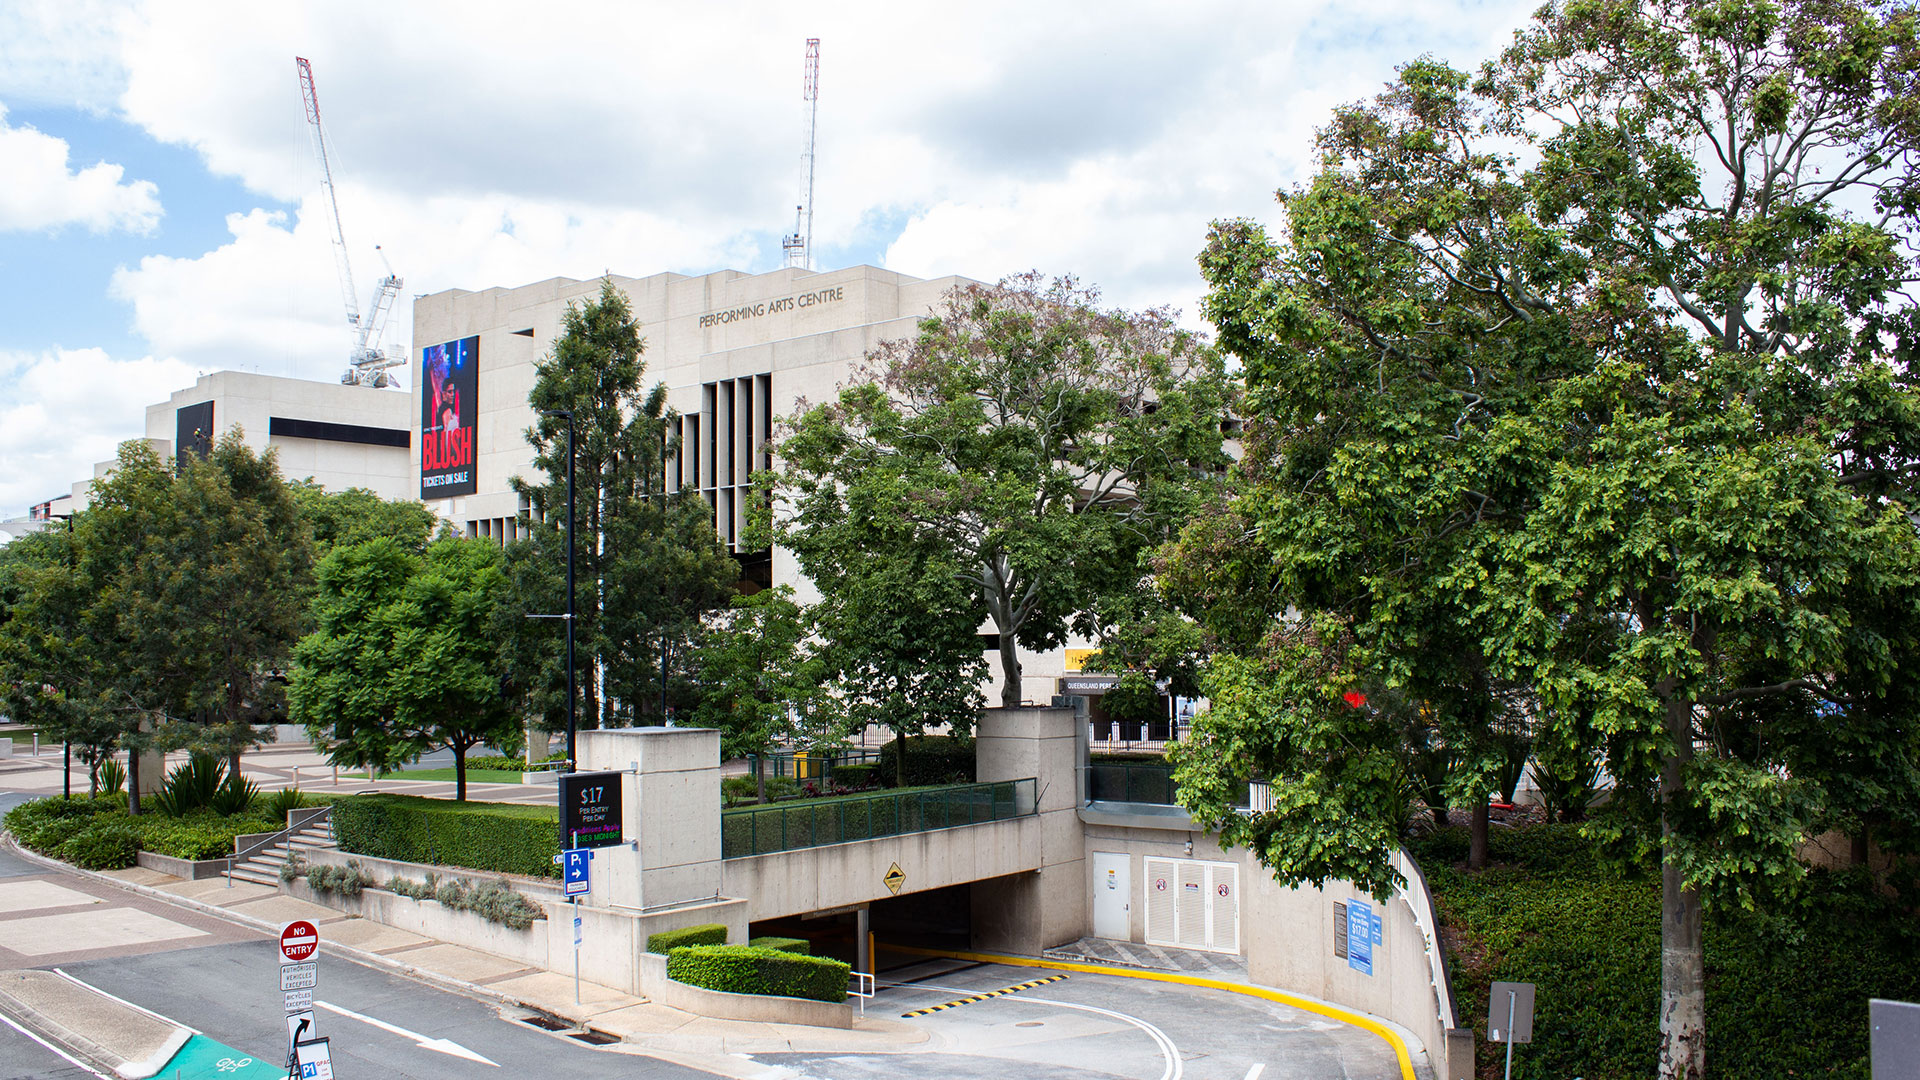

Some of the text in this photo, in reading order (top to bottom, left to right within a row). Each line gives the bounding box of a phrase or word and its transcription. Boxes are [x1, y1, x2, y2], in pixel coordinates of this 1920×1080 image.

[699, 287, 843, 328] PERFORMING ARTS CENTRE
[423, 426, 472, 471] BLUSH
[423, 471, 468, 488] TICKETS ON SALE
[1067, 682, 1099, 690] QUEENSLAND
[580, 786, 604, 805] $17
[569, 834, 593, 844] COSES
[293, 927, 306, 936] NO
[285, 944, 313, 956] ENTRY
[282, 964, 316, 974] AUTHORISED
[286, 972, 313, 981] VEHICLES
[285, 979, 313, 989] EXCEPTED
[286, 992, 311, 1001] BICYCLES
[286, 999, 311, 1008] EXCEPTED
[302, 1063, 316, 1078] P1
